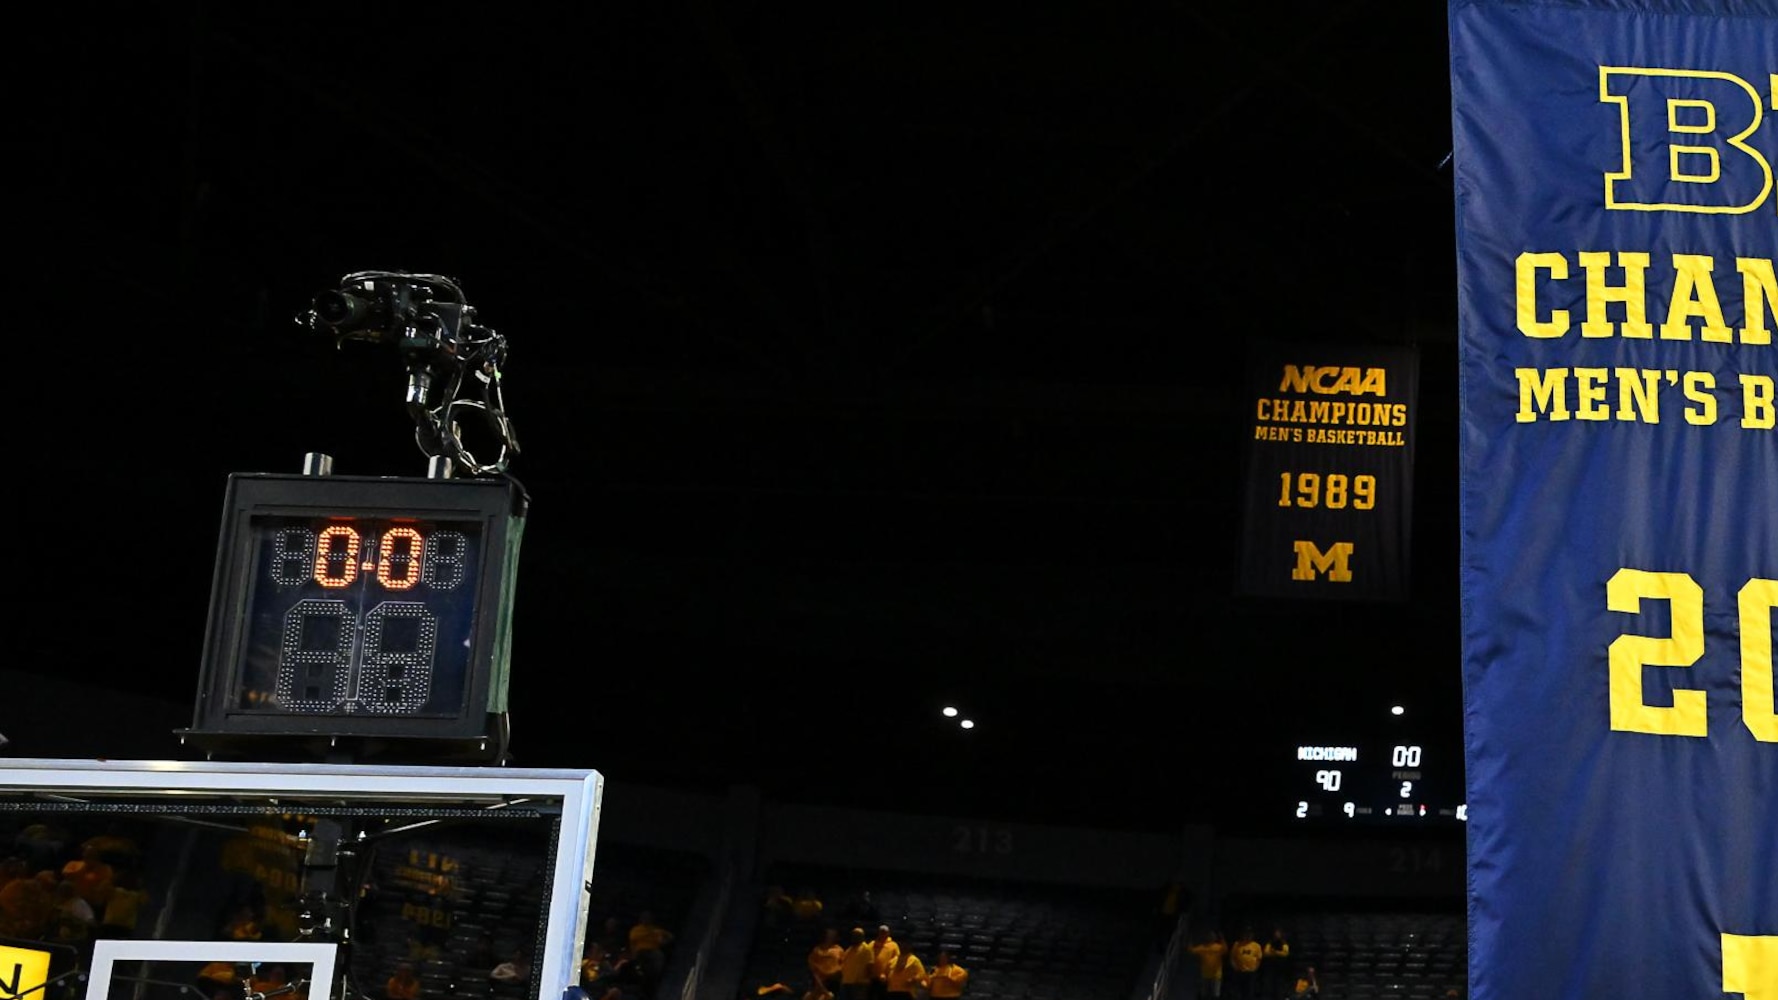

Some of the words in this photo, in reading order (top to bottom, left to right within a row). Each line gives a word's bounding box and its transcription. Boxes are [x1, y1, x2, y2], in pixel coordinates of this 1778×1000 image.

[1279, 364, 1387, 397] NCAA
[1515, 367, 1718, 424] MEN'S
[1257, 398, 1407, 427] CHAMPIONS
[1255, 425, 1302, 442] MEN'S
[1307, 429, 1405, 446] BASKETBALL
[1278, 472, 1377, 510] 1989
[1292, 540, 1354, 582] M
[1297, 746, 1357, 761] MICHIGAN
[1316, 770, 1341, 791] 90
[1400, 781, 1412, 798] 2
[1296, 802, 1308, 818] 2
[1344, 802, 1355, 818] 9
[952, 824, 1013, 854] 213
